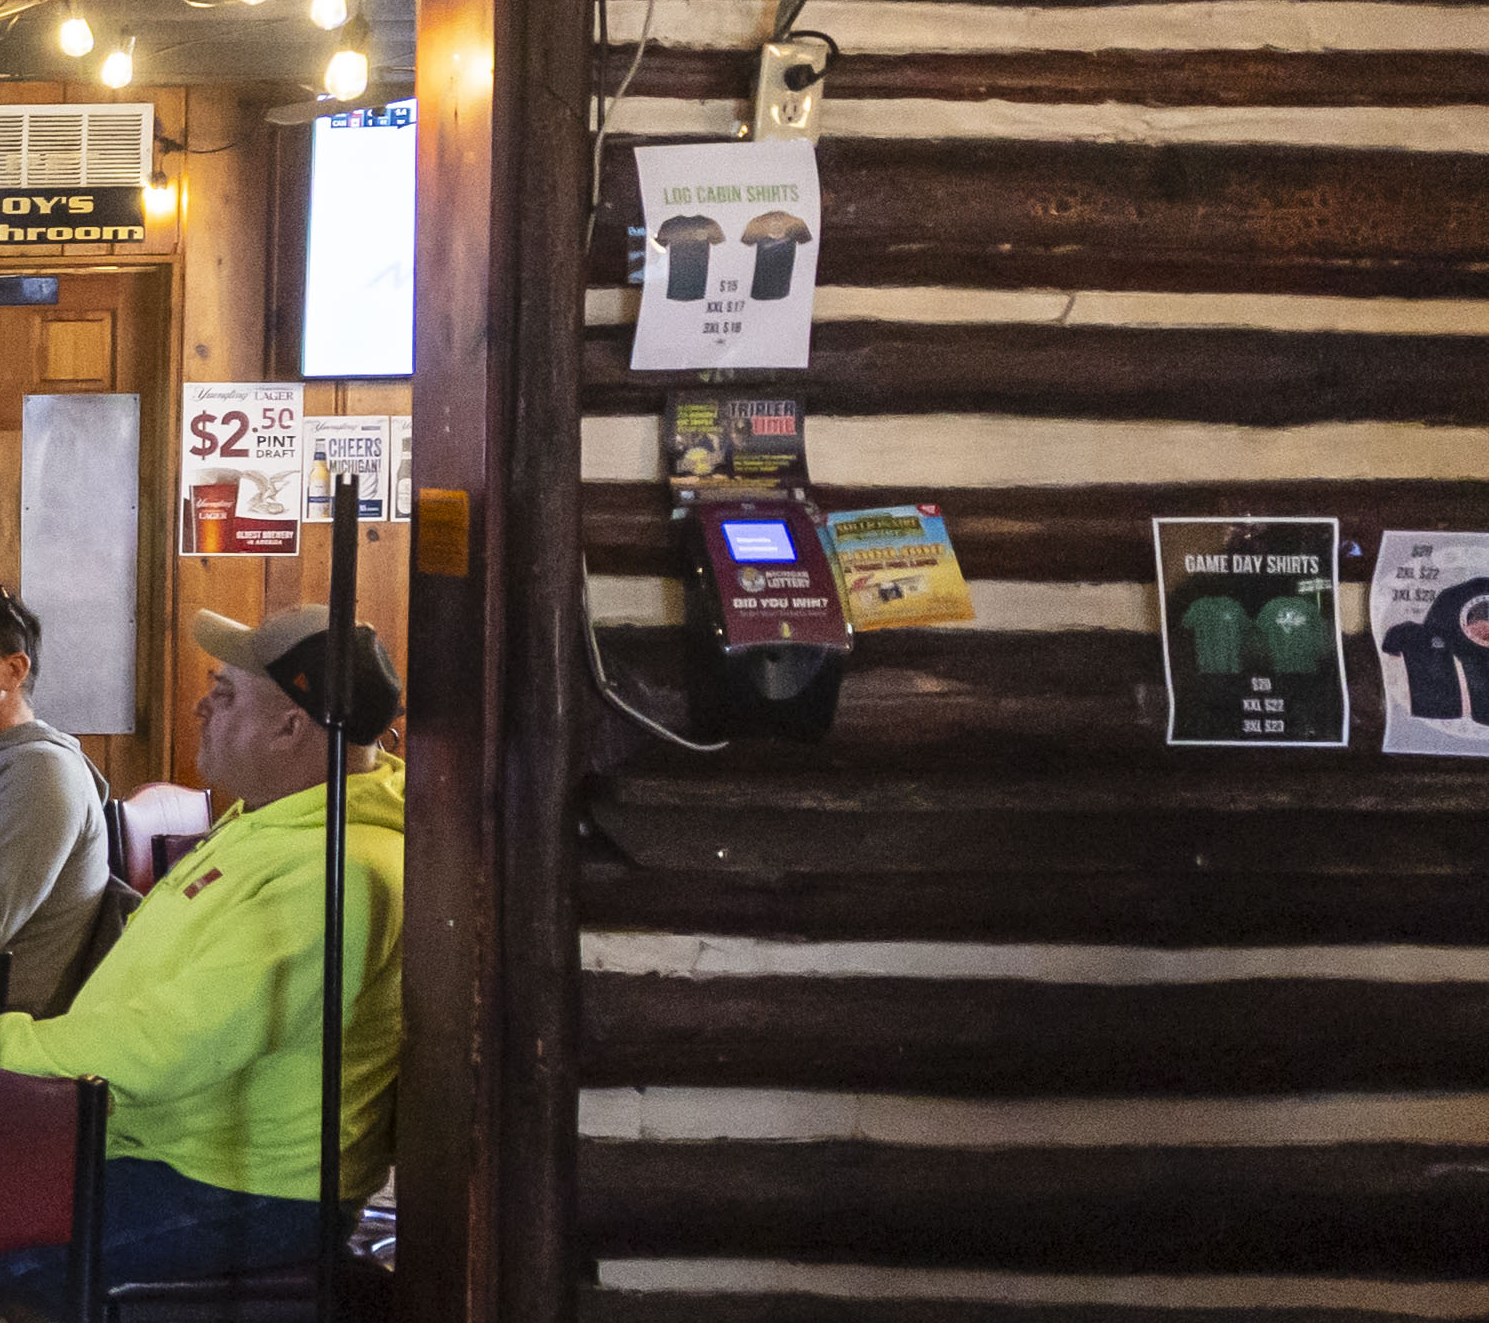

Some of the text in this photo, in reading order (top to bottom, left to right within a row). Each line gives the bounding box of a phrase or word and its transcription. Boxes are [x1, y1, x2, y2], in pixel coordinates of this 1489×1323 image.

[663, 184, 800, 205] LOG CABIN SHIRTS
[193, 388, 294, 402] Yuengling LAGER
[189, 408, 294, 461] $2.50
[257, 435, 296, 447] PINT
[256, 450, 296, 458] DRAFT
[329, 438, 382, 457] CHEERS
[329, 459, 382, 473] MICHIGAN!
[1184, 554, 1320, 575] GAME DAY SHIRTS
[766, 571, 809, 580] MICHIGAN
[767, 578, 810, 589] LOTTERY
[733, 598, 757, 609] DID
[760, 598, 789, 609] YOU
